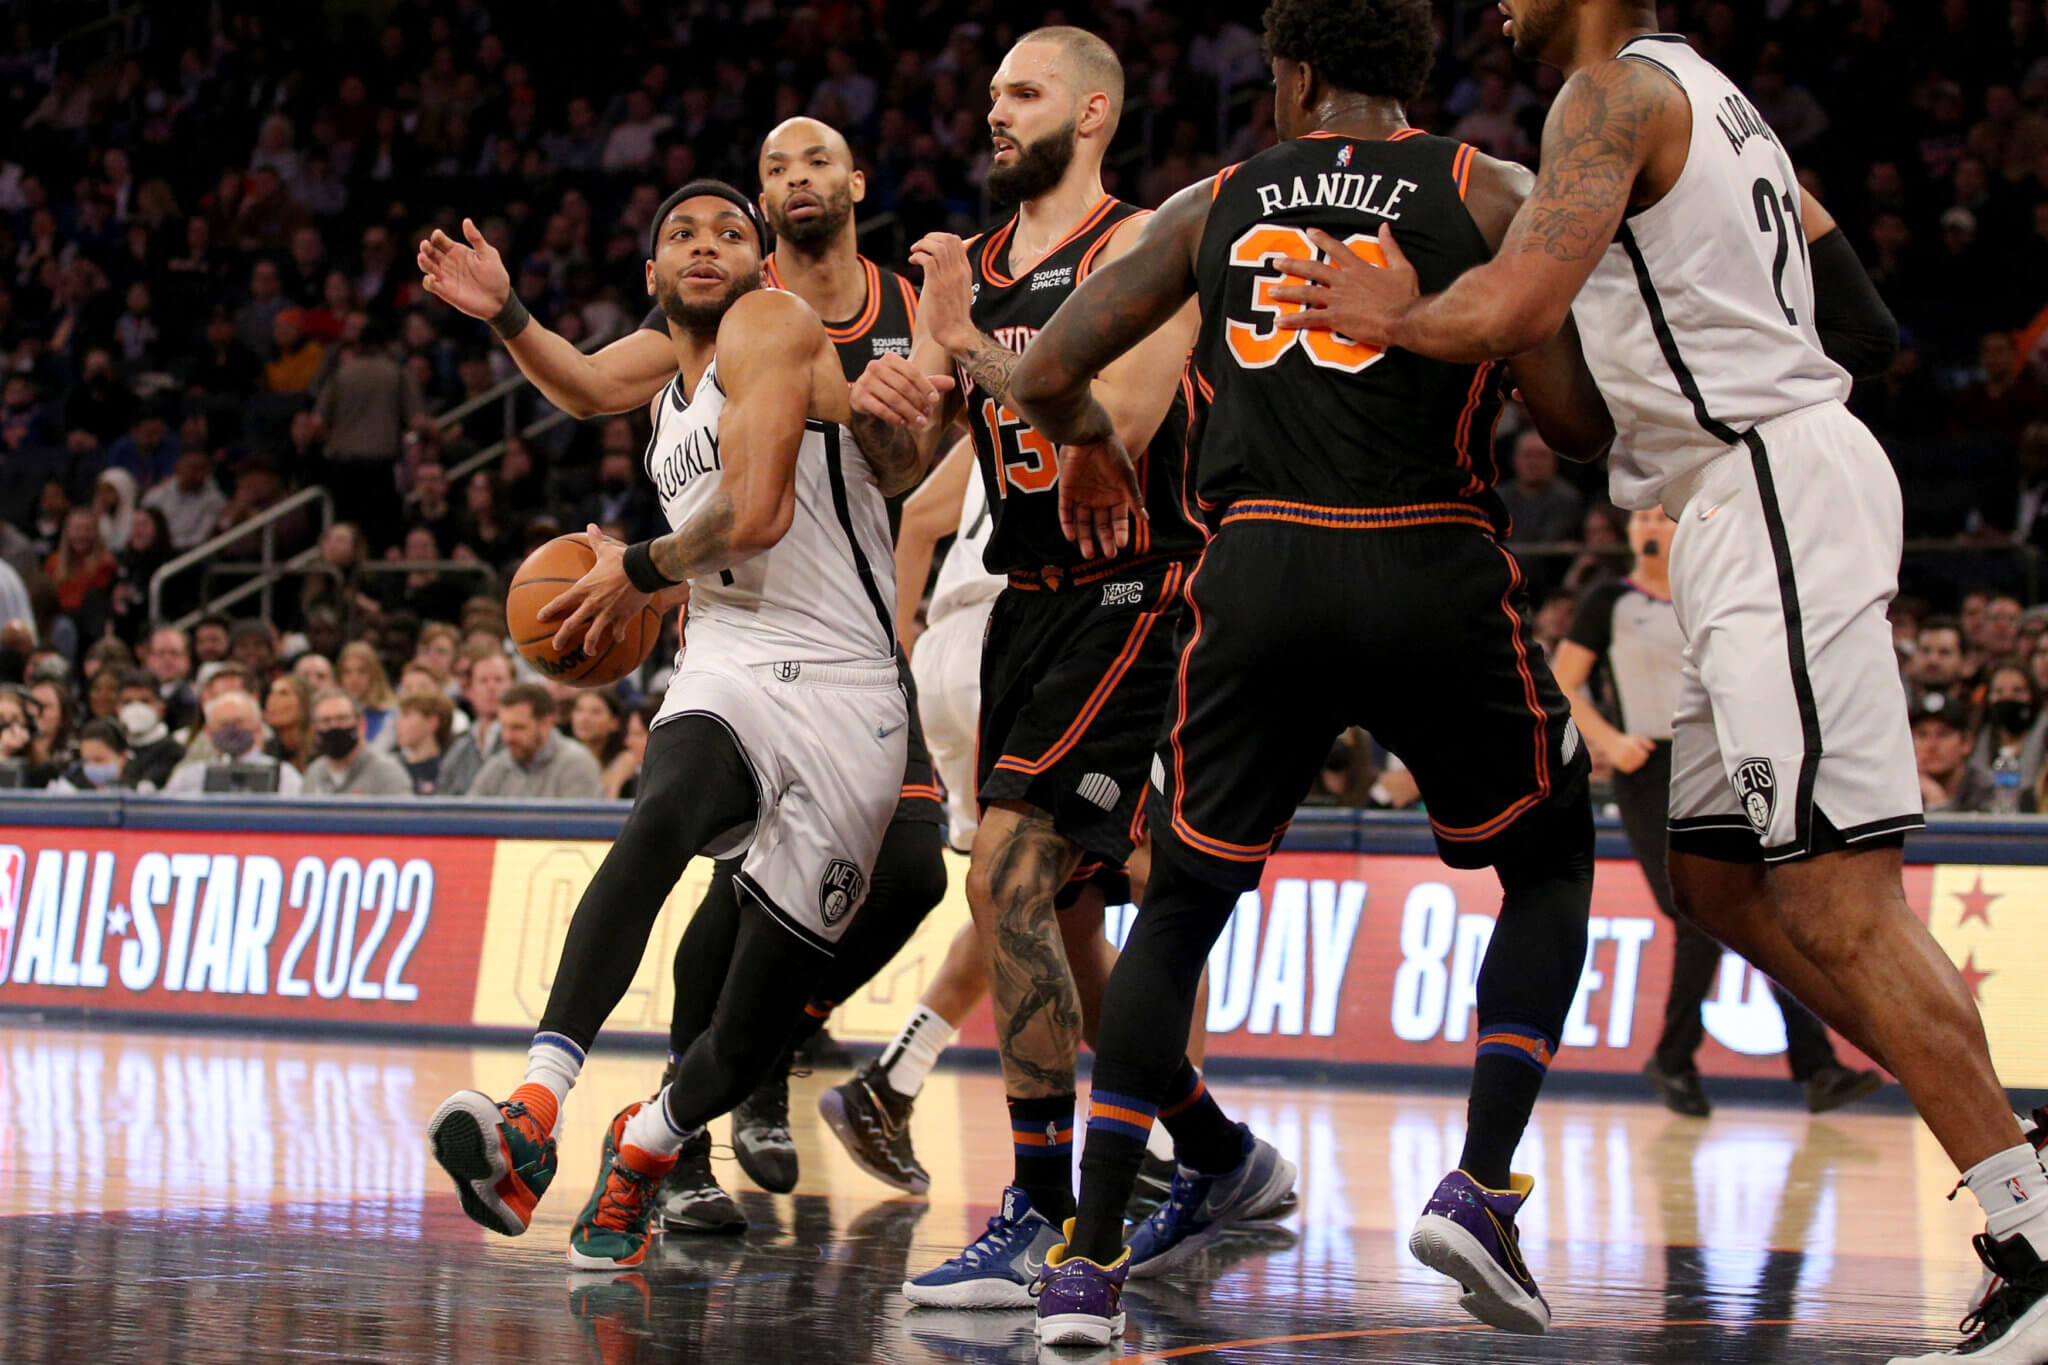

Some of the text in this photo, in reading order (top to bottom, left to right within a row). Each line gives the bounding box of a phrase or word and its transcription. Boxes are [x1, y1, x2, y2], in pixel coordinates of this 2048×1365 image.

[1256, 172, 1418, 220] RANDLE
[1030, 278, 1061, 291] SPACE
[1033, 267, 1072, 281] SQUARE
[993, 325, 1041, 356] YO
[656, 426, 721, 503] ROOKLY
[982, 397, 1060, 500] 13
[1733, 762, 1773, 797] NETS
[825, 864, 863, 901] NETS
[12, 849, 115, 987] ALL
[119, 852, 283, 996] STAR
[276, 856, 434, 1001] 2022
